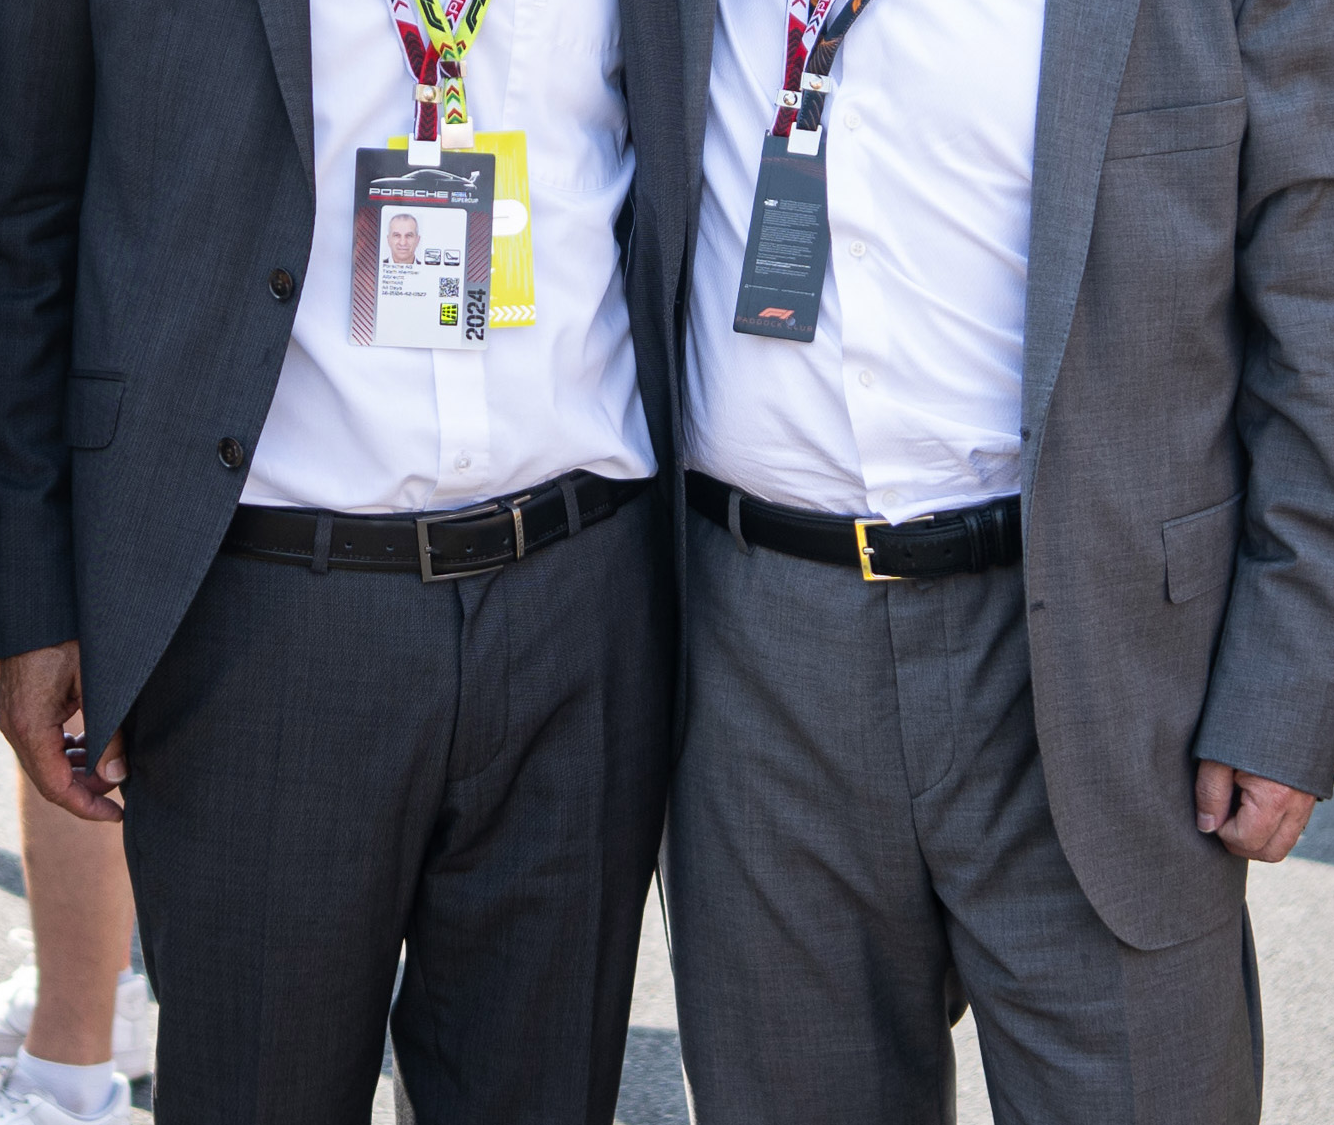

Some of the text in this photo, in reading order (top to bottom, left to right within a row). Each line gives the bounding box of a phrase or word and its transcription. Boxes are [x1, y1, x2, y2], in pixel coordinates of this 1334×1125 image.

[369, 187, 449, 199] PORSCHE
[465, 288, 486, 341] 2024
[736, 315, 783, 328] PADDOCK
